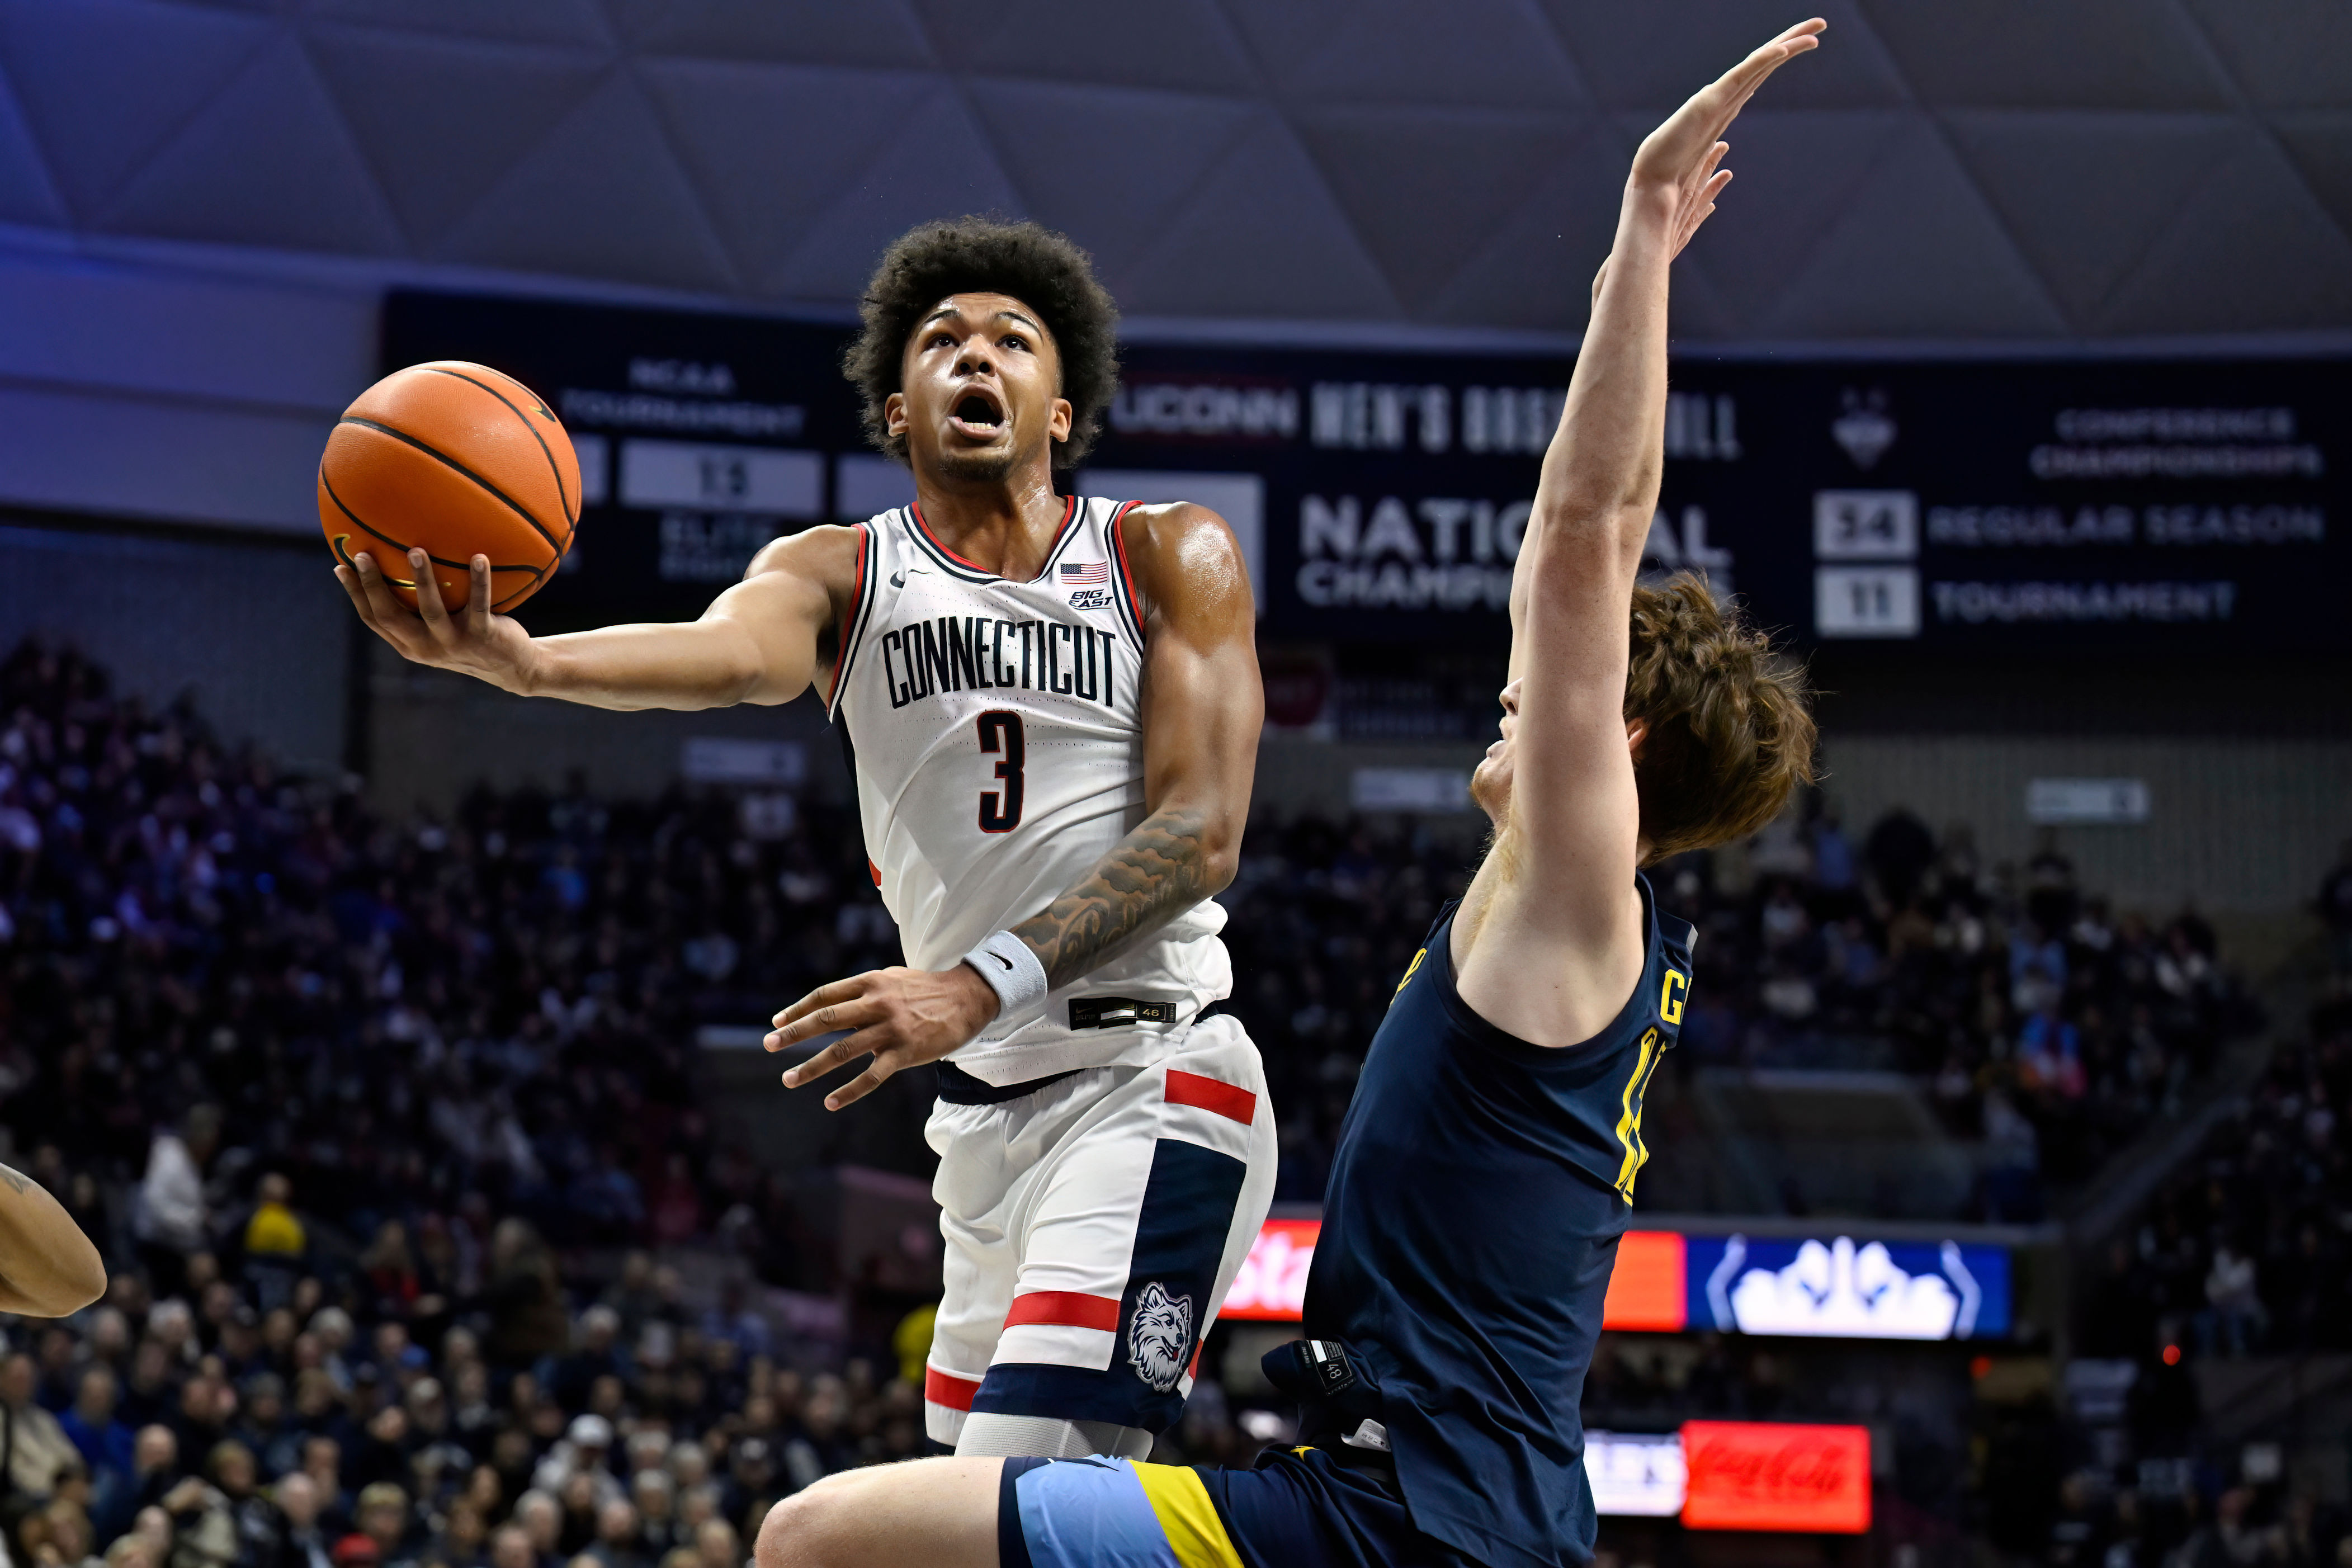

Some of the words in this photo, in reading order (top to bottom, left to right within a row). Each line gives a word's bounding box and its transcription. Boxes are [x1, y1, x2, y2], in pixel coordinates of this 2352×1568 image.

[1110, 385, 1298, 437] UCONN
[1928, 504, 2134, 547] REGULAR
[2145, 503, 2326, 546] SEASON
[1069, 597, 1113, 608] EAST
[1071, 589, 1104, 599] BIG
[1931, 580, 2238, 623] TOURNAMENT
[882, 616, 1116, 709] CONNECTICUT
[976, 710, 1025, 833] 3
[1326, 1364, 1342, 1379] 48
